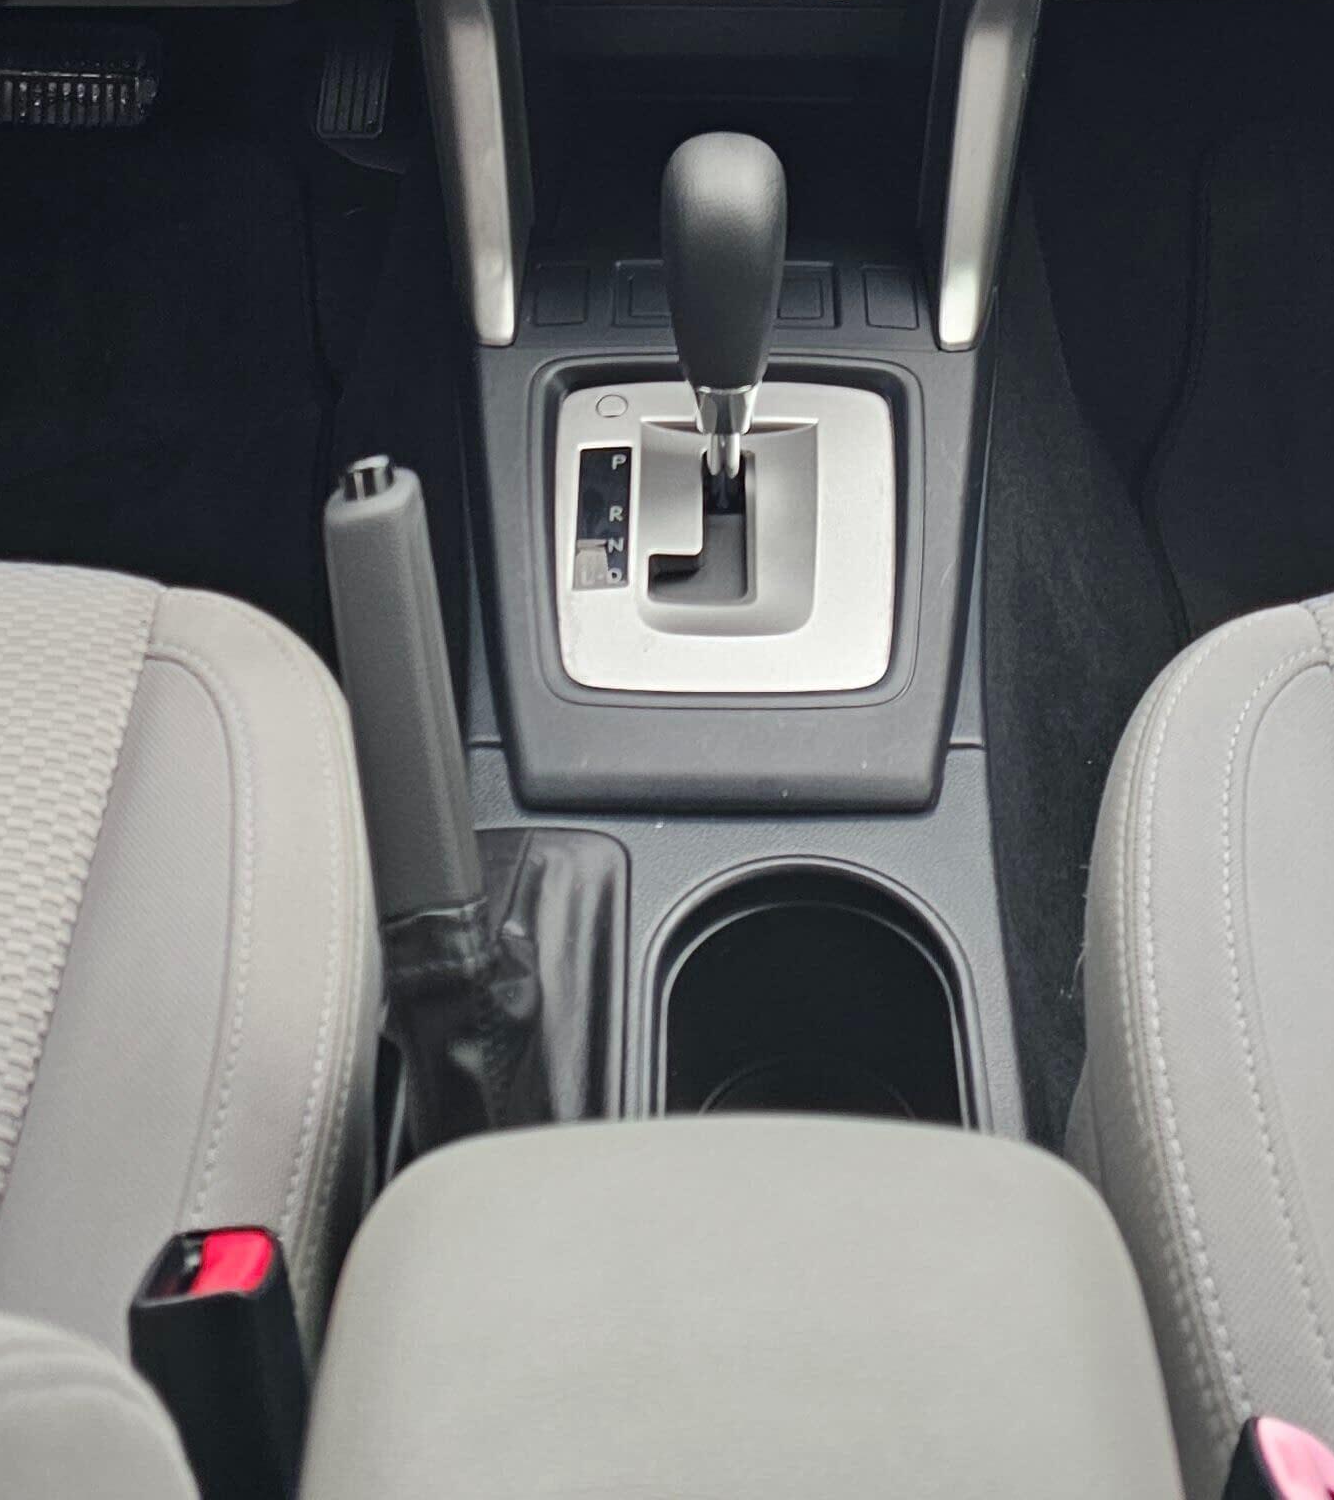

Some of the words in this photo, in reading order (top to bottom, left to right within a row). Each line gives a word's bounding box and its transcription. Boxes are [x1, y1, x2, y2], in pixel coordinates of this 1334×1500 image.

[612, 454, 626, 470] P
[610, 505, 623, 522] R
[608, 537, 624, 553] N
[608, 567, 623, 583] D
